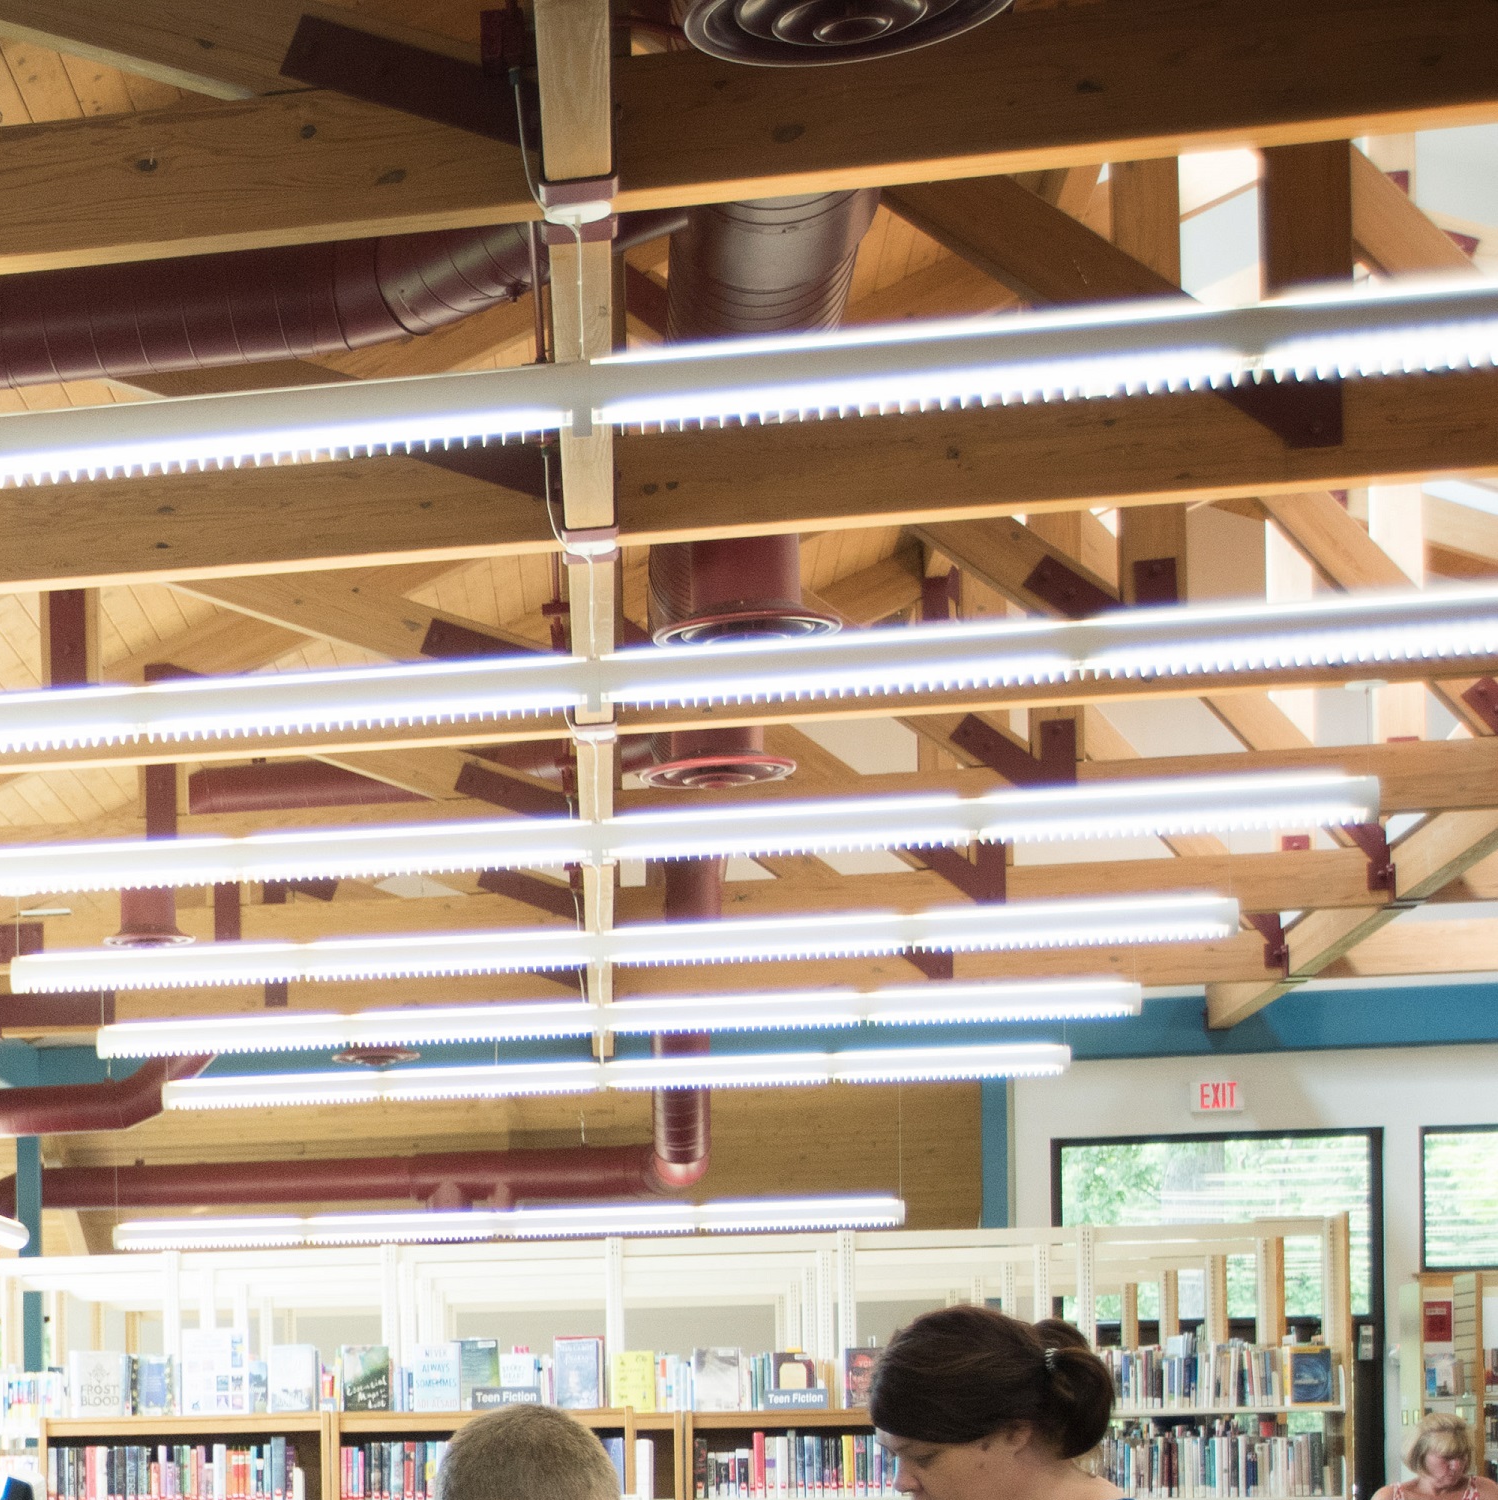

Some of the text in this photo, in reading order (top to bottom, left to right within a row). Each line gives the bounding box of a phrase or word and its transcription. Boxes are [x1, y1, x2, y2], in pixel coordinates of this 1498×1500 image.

[1200, 1082, 1237, 1109] EXIT
[424, 1349, 447, 1358] NEVER
[421, 1363, 450, 1374] ALWAYS
[80, 1383, 120, 1395] FROST
[415, 1378, 457, 1389] SOMETIMES
[80, 1396, 120, 1407] BLOOD
[475, 1390, 537, 1403] Teen Fiction
[768, 1392, 824, 1404] Teen Fiction
